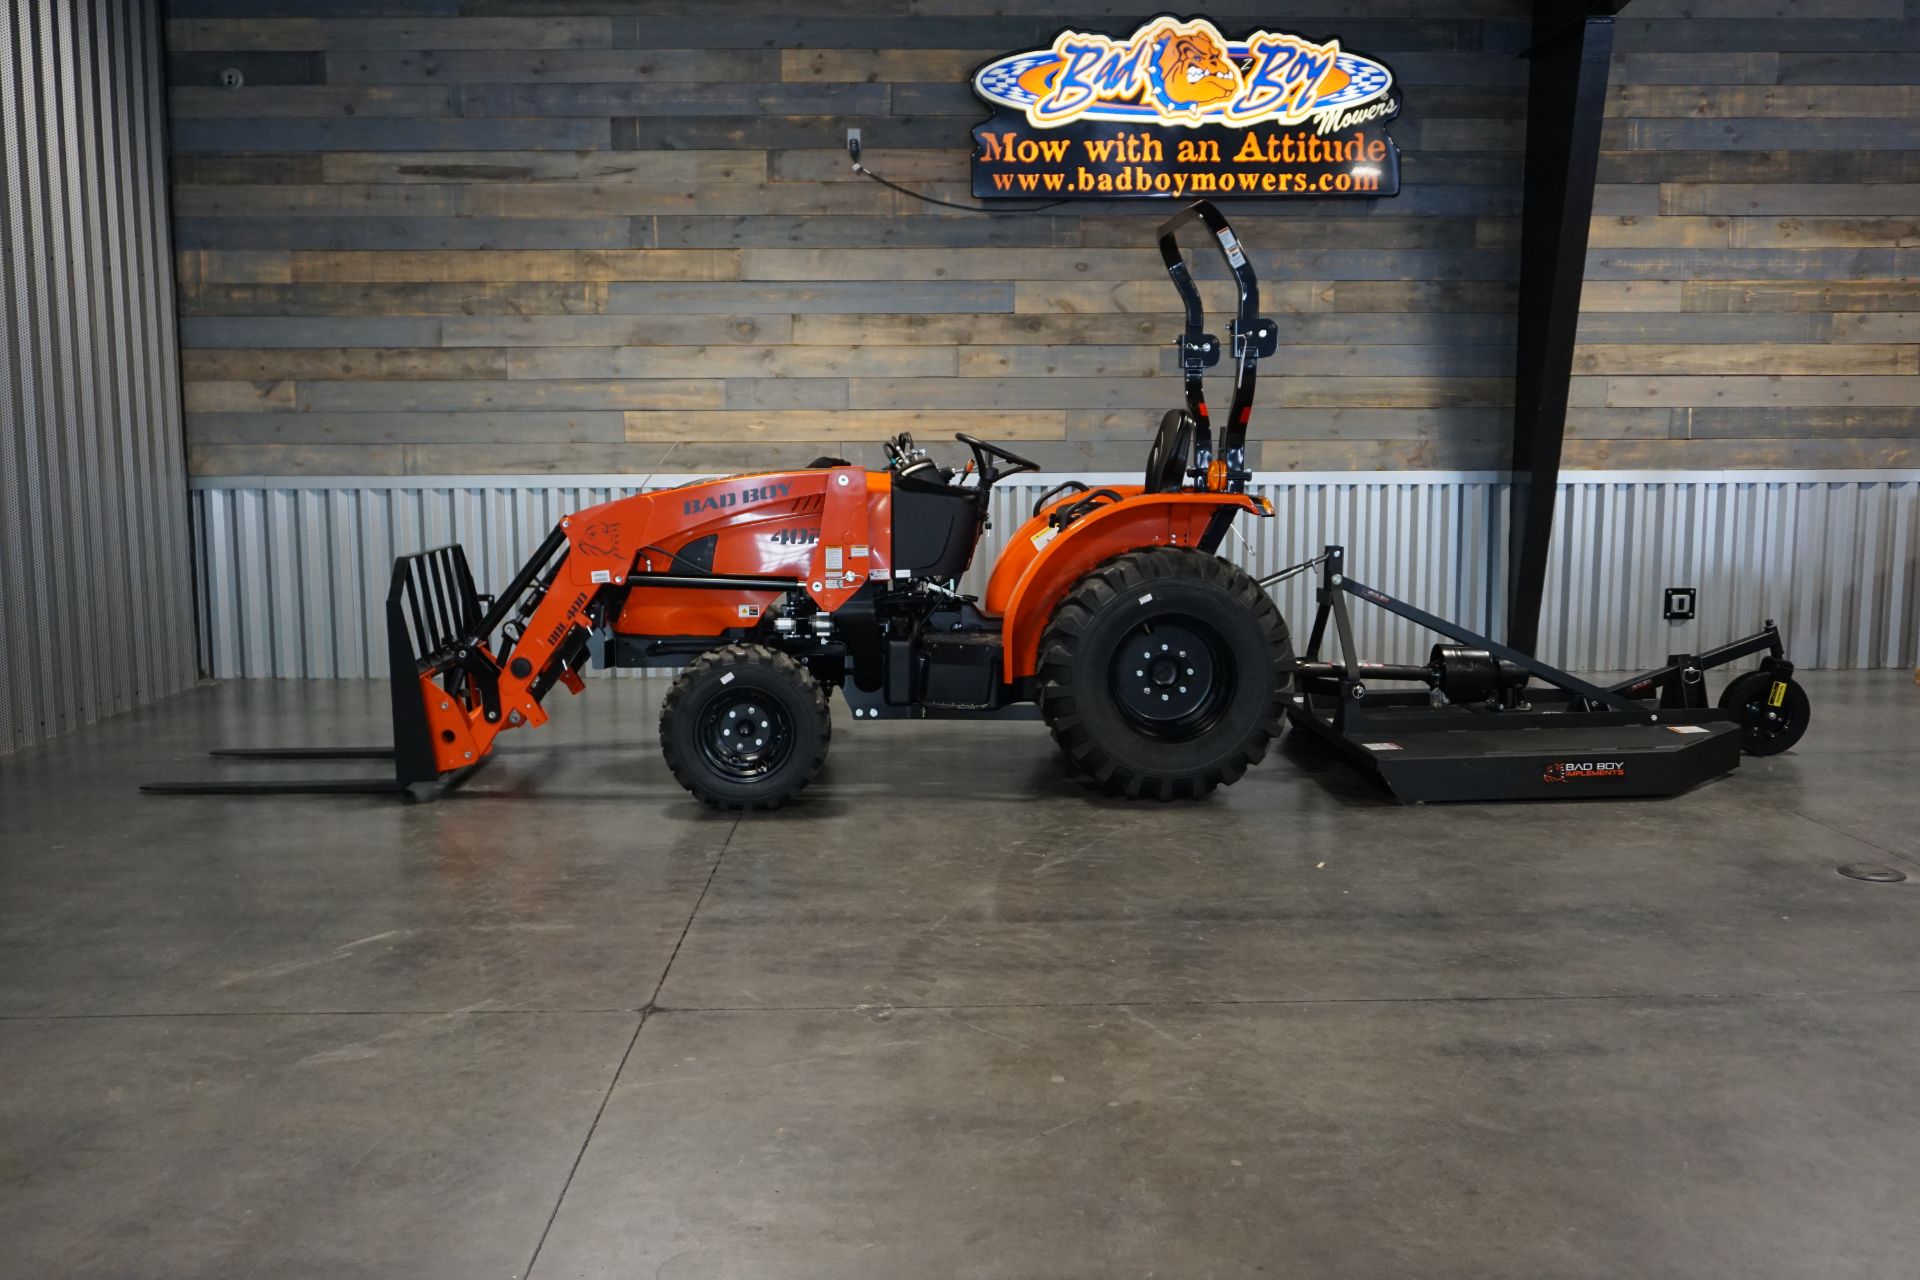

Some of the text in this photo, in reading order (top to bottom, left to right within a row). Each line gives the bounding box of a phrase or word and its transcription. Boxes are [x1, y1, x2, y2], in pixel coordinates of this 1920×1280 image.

[1039, 39, 1330, 114] Bad Boy
[1313, 98, 1397, 136] Mowers
[979, 131, 1386, 163] Mow with an Attitude
[992, 166, 1380, 198] www.badboymowers.com
[683, 482, 793, 516] BAD BOY
[1565, 761, 1625, 771] BAD BOY
[1565, 769, 1625, 777] IMPLEMENTS
